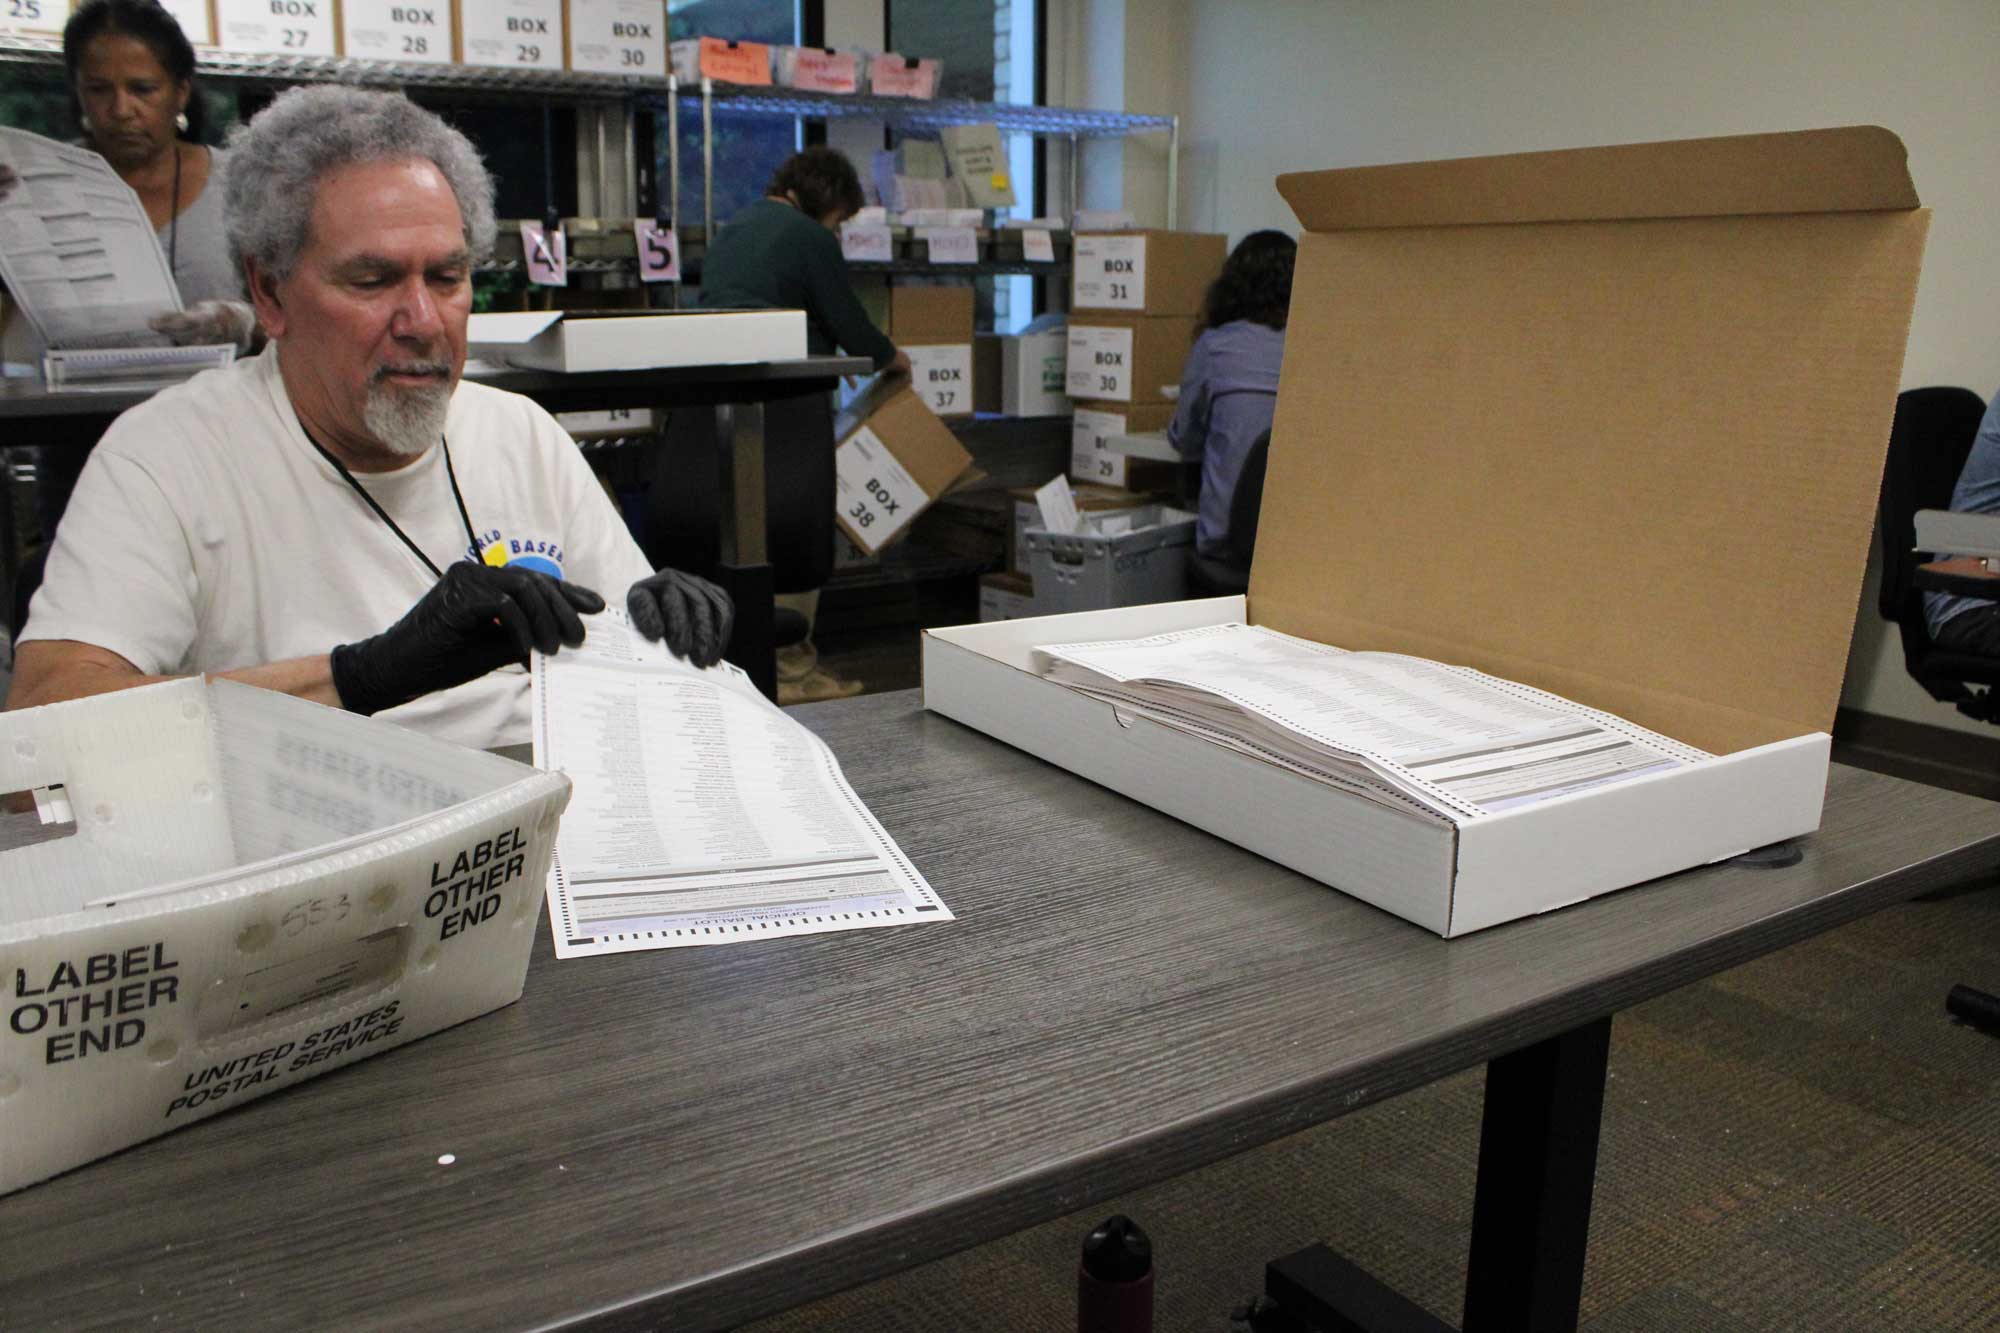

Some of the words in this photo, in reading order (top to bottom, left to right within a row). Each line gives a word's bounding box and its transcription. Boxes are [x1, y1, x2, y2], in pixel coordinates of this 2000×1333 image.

[9, 0, 42, 20] 25
[269, 0, 318, 18] BOX
[390, 7, 436, 26] BOX
[506, 16, 549, 34] BOX
[612, 22, 653, 38] BOX
[281, 28, 309, 48] 27
[402, 35, 429, 53] 28
[516, 45, 541, 63] 29
[621, 48, 645, 66] 30
[533, 238, 559, 273] 4
[646, 230, 671, 270] 5
[1104, 260, 1134, 273] BOX
[1110, 284, 1127, 299] 31
[1095, 352, 1122, 365] BOX
[929, 368, 961, 382] BOX
[1100, 376, 1117, 391] 30
[936, 392, 955, 407] 37
[1100, 461, 1114, 476] 29
[865, 478, 900, 515] BOX
[849, 501, 876, 529] 38
[431, 827, 527, 888] LABEL
[424, 853, 524, 918] OTHER
[440, 894, 501, 941] END
[693, 917, 745, 926] BALLOT
[752, 911, 806, 920] OFFICIAL
[16, 942, 179, 998] LABEL
[10, 976, 179, 1034] OTHER
[46, 1018, 146, 1065] END
[184, 1042, 296, 1092] UNITED
[300, 1000, 400, 1051] STATES
[164, 1065, 281, 1119] POSTAL
[289, 1016, 405, 1073] SERVICE
